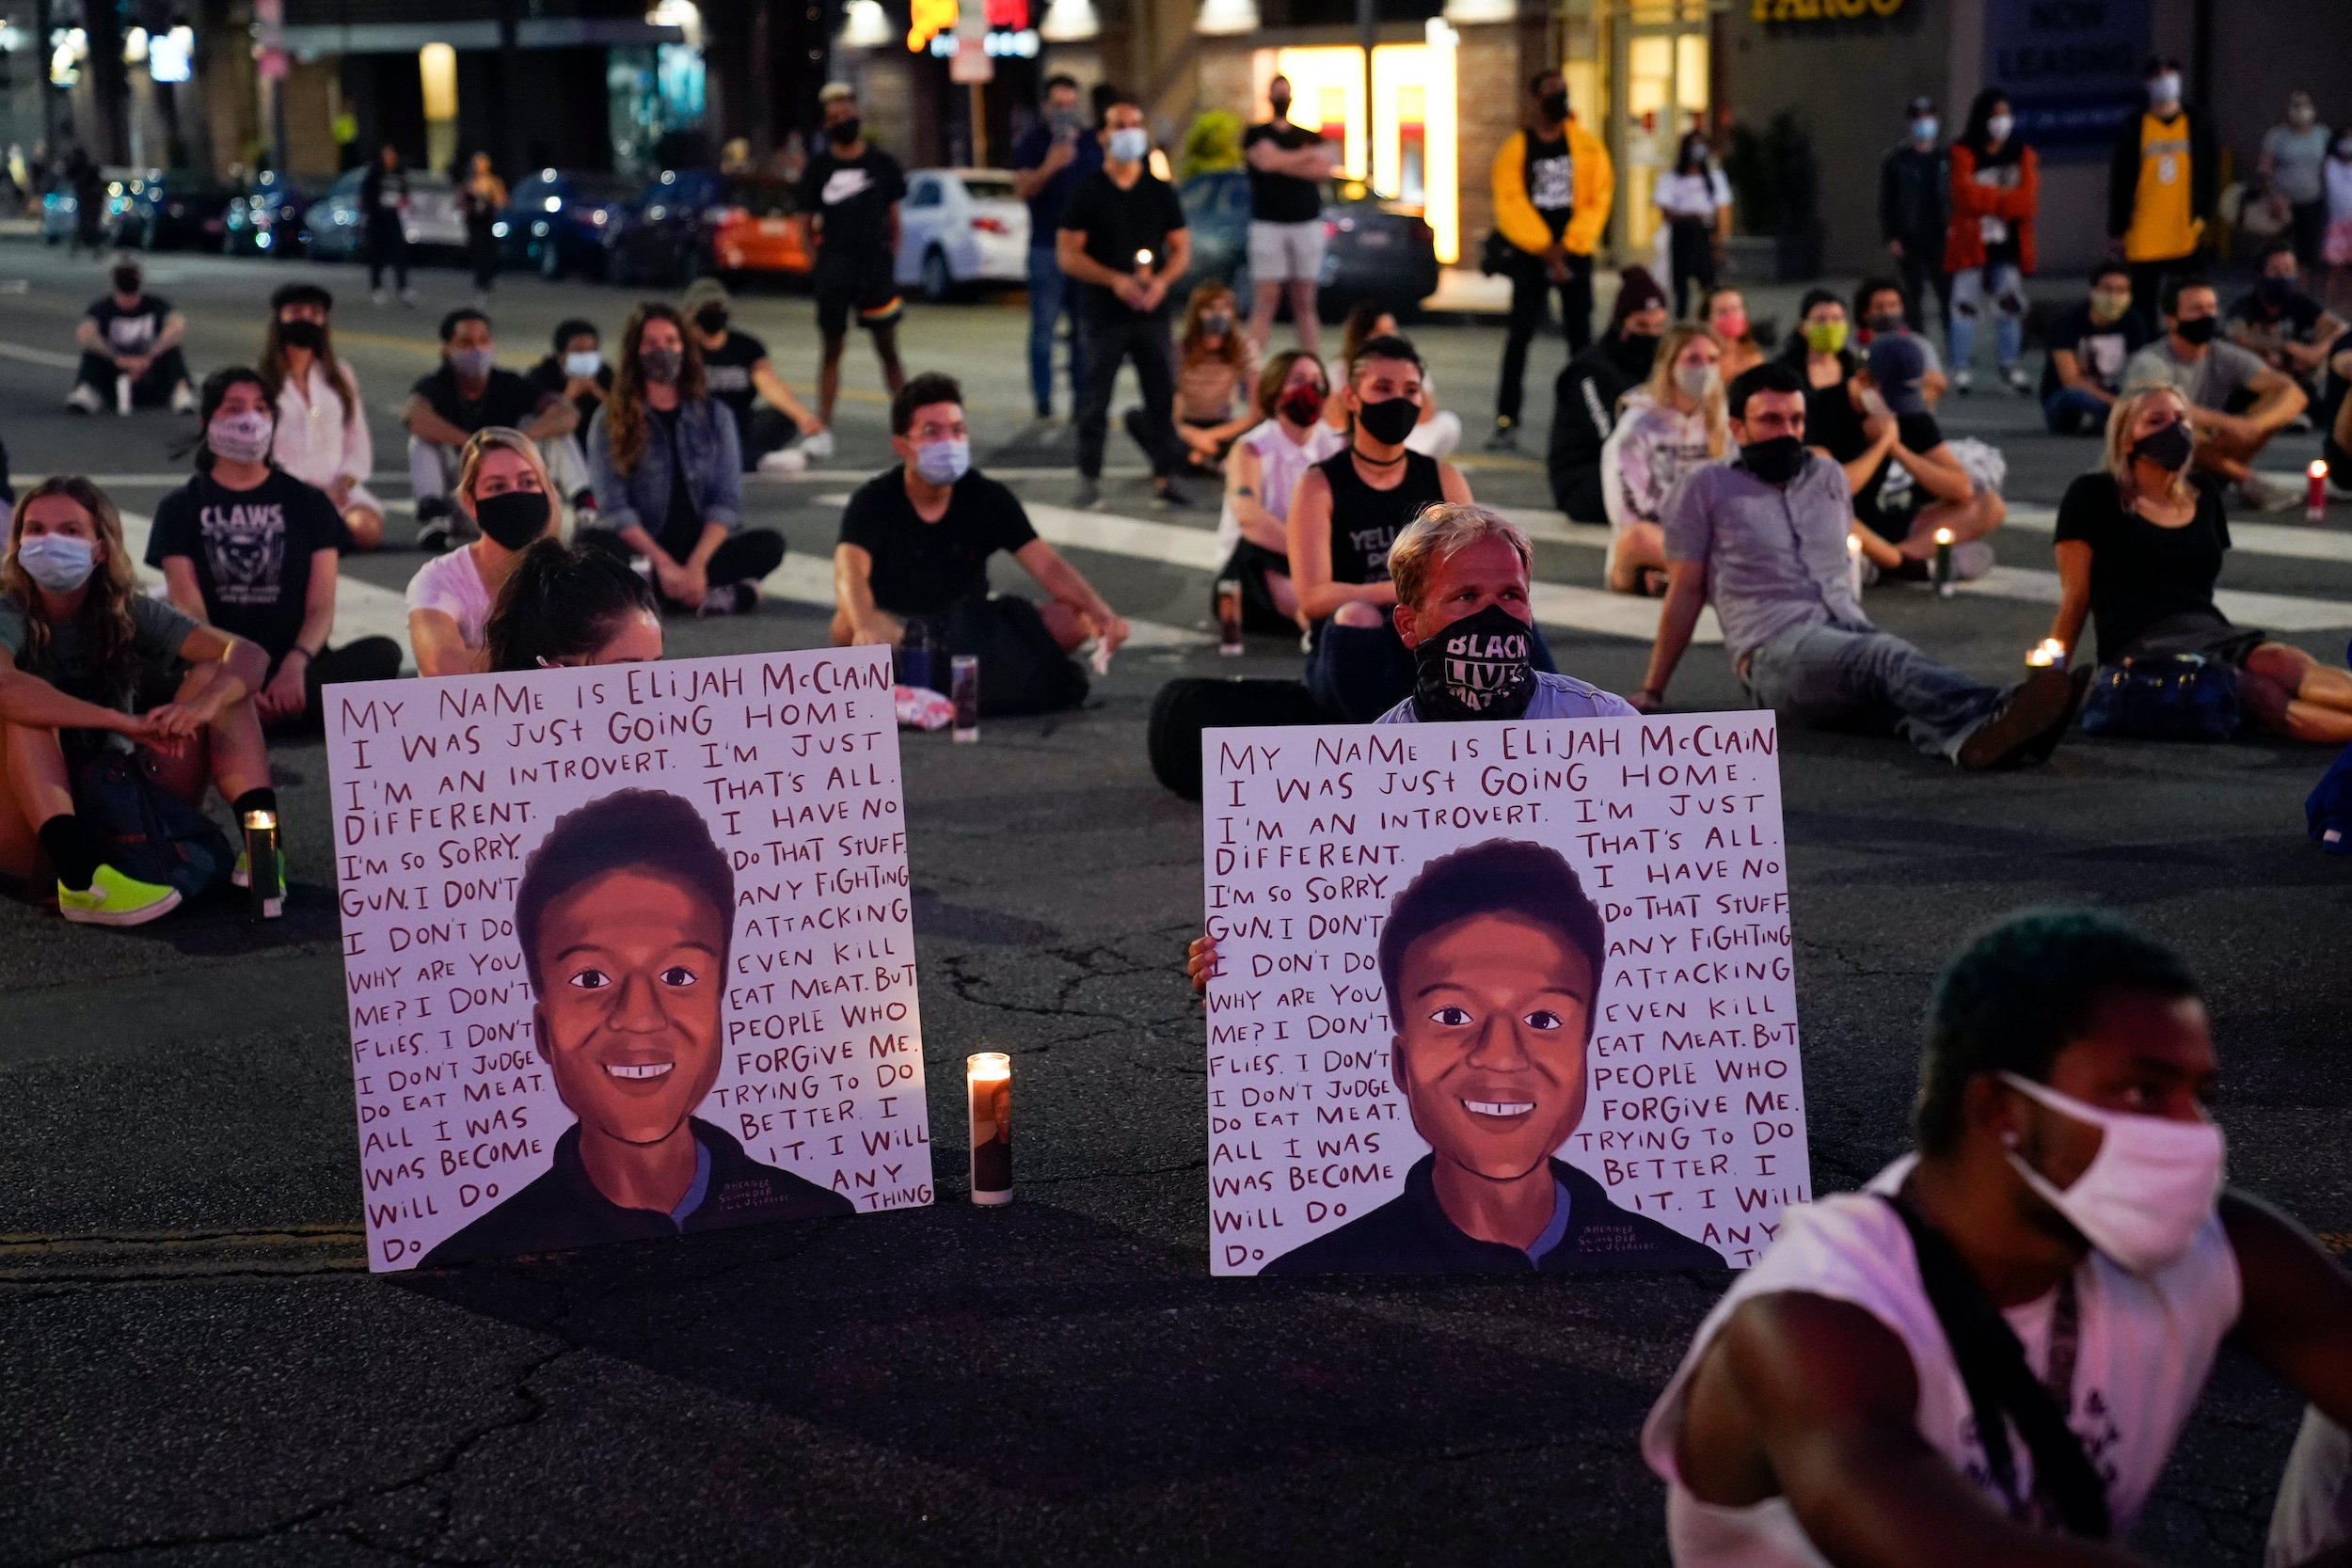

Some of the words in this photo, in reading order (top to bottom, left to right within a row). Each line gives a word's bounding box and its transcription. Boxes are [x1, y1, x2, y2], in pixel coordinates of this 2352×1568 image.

[200, 504, 285, 535] CLAWS
[1446, 634, 1526, 659] BLACK
[342, 698, 404, 736] MY
[440, 683, 543, 721] NAME
[579, 684, 604, 708] IS
[352, 739, 372, 769] I
[402, 725, 480, 762] WAS
[746, 702, 873, 729] HOME.
[1221, 742, 1280, 775] MY
[1315, 735, 1417, 767] NAME
[1453, 739, 1478, 762] IS
[343, 781, 412, 810] I'M
[439, 770, 485, 795] AN
[509, 749, 675, 785] INTROVERT.
[700, 743, 756, 768] I'M
[792, 732, 882, 756] JUST
[703, 771, 804, 804] THAT'S
[827, 763, 894, 790] ALL.
[1228, 780, 1246, 807] I
[1277, 772, 1353, 803] WAS
[1623, 764, 1756, 787] HOME.
[340, 855, 388, 880] I'M
[439, 832, 520, 868] SORRY.
[722, 811, 741, 835] I
[772, 801, 849, 828] HAVE
[863, 799, 897, 819] NO
[1216, 817, 1282, 844] I'M
[1310, 814, 1355, 835] AN
[1381, 803, 1548, 830] INTROVERT.
[1574, 800, 1632, 822] I'M
[1669, 795, 1764, 816] JUST
[1576, 829, 1682, 858] THAT'S
[1706, 825, 1776, 849] ALL.
[341, 887, 408, 917] GUN.
[414, 887, 428, 909] I
[445, 878, 518, 908] DON'T
[763, 837, 824, 865] THAT
[1209, 885, 1254, 908] I'M
[1306, 873, 1388, 903] SORRY.
[1594, 865, 1613, 888] I
[1647, 861, 1727, 884] HAVE
[1742, 859, 1779, 879] NO
[343, 932, 366, 956] I
[389, 918, 467, 952] DON'T
[739, 880, 803, 907] ANY
[348, 967, 401, 994] WHY
[418, 960, 455, 981] ARE
[469, 953, 520, 975] YOU
[356, 1001, 406, 1028] ME?
[415, 997, 431, 1017] I
[449, 981, 528, 1014] DON'T
[738, 949, 812, 974] EVEN
[439, 1030, 453, 1049] I
[468, 1020, 532, 1048] DON'T
[730, 984, 774, 1010] EAT
[792, 974, 868, 1000] MEAT.
[876, 964, 914, 991] BUT
[1209, 990, 1262, 1013] WHY
[1278, 988, 1315, 1006] ARE
[1330, 984, 1382, 1006] YOU
[1213, 1022, 1264, 1045] ME?
[1273, 1022, 1289, 1039] I
[1308, 1012, 1388, 1039] DON'T
[1606, 1002, 1685, 1022] EVEN
[1295, 1054, 1308, 1071] I
[1325, 1049, 1390, 1072] DON'T
[1597, 1034, 1645, 1057] EAT
[1662, 1030, 1745, 1051] MEAT.
[1754, 1022, 1796, 1049] BUT
[357, 1076, 373, 1094] I
[389, 1062, 457, 1091] DON'T
[472, 1051, 534, 1074] JUDGE
[729, 1009, 823, 1045] PEOPLE
[841, 1003, 906, 1028] WHO
[404, 1093, 446, 1111] EAT
[464, 1074, 545, 1101] MEAT.
[870, 1034, 917, 1058] ME.
[1212, 1090, 1226, 1107] I
[1242, 1083, 1312, 1107] DON'T
[1327, 1079, 1390, 1099] JUDGE
[1595, 1063, 1696, 1091] PEOPLE
[1716, 1059, 1787, 1083] WHO
[365, 1127, 413, 1158] ALL
[433, 1120, 452, 1141] I
[466, 1106, 527, 1138] WAS
[1255, 1112, 1299, 1126] EAT
[1317, 1103, 1400, 1124] MEAT.
[1746, 1091, 1799, 1115] ME.
[365, 1157, 424, 1191] WAS
[441, 1139, 542, 1176] BECOME
[740, 1100, 862, 1140] BETTER.
[879, 1097, 898, 1118] I
[770, 1141, 813, 1163] IT.
[827, 1135, 843, 1155] I
[1213, 1141, 1262, 1166] ALL
[1283, 1138, 1301, 1158] I
[1317, 1132, 1380, 1158] WAS
[833, 1164, 902, 1190] ANY
[861, 1184, 931, 1210] THING
[1213, 1171, 1273, 1198] WAS
[1290, 1164, 1393, 1192] BECOME
[1603, 1156, 1737, 1187] BETTER.
[1755, 1155, 1775, 1176] I
